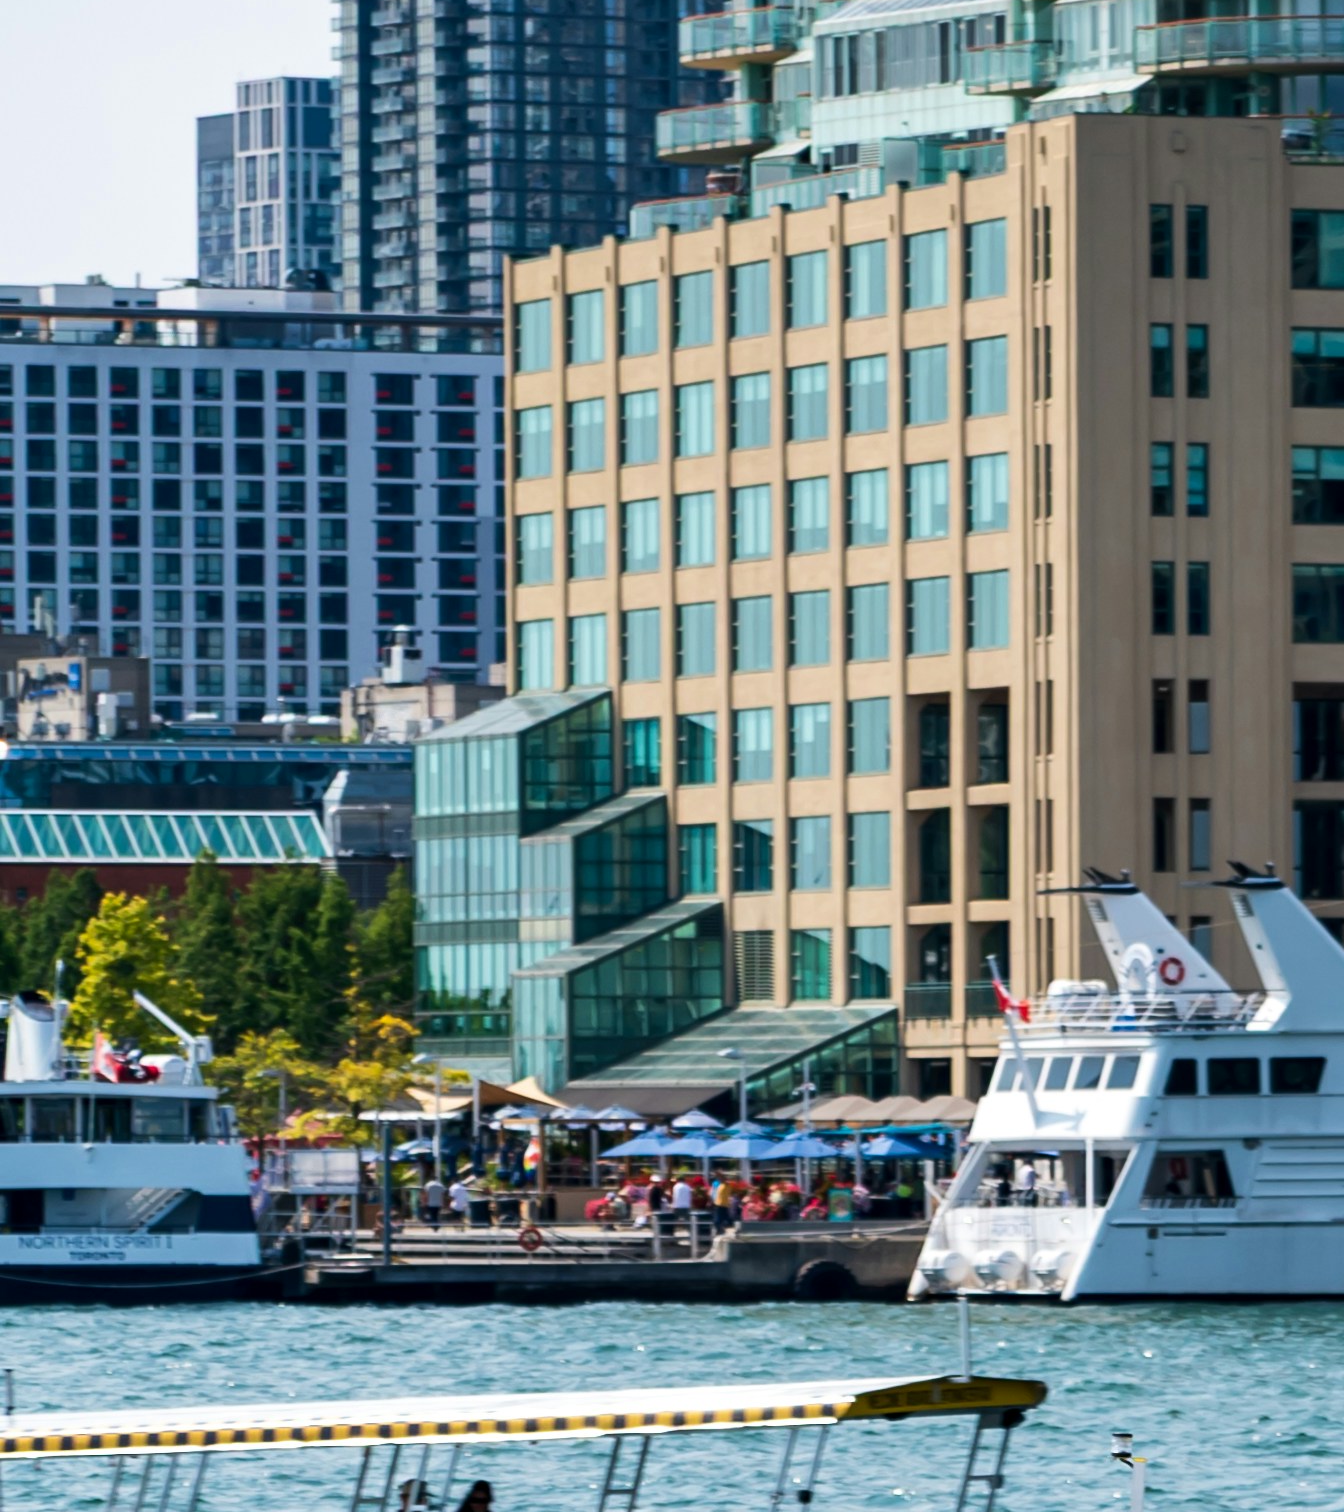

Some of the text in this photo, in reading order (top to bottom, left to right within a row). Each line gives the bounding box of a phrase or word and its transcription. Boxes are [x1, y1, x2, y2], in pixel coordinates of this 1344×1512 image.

[18, 1236, 109, 1249] NORTHERN
[114, 1236, 161, 1249] SPIRIT
[69, 1251, 126, 1261] TORONTO
